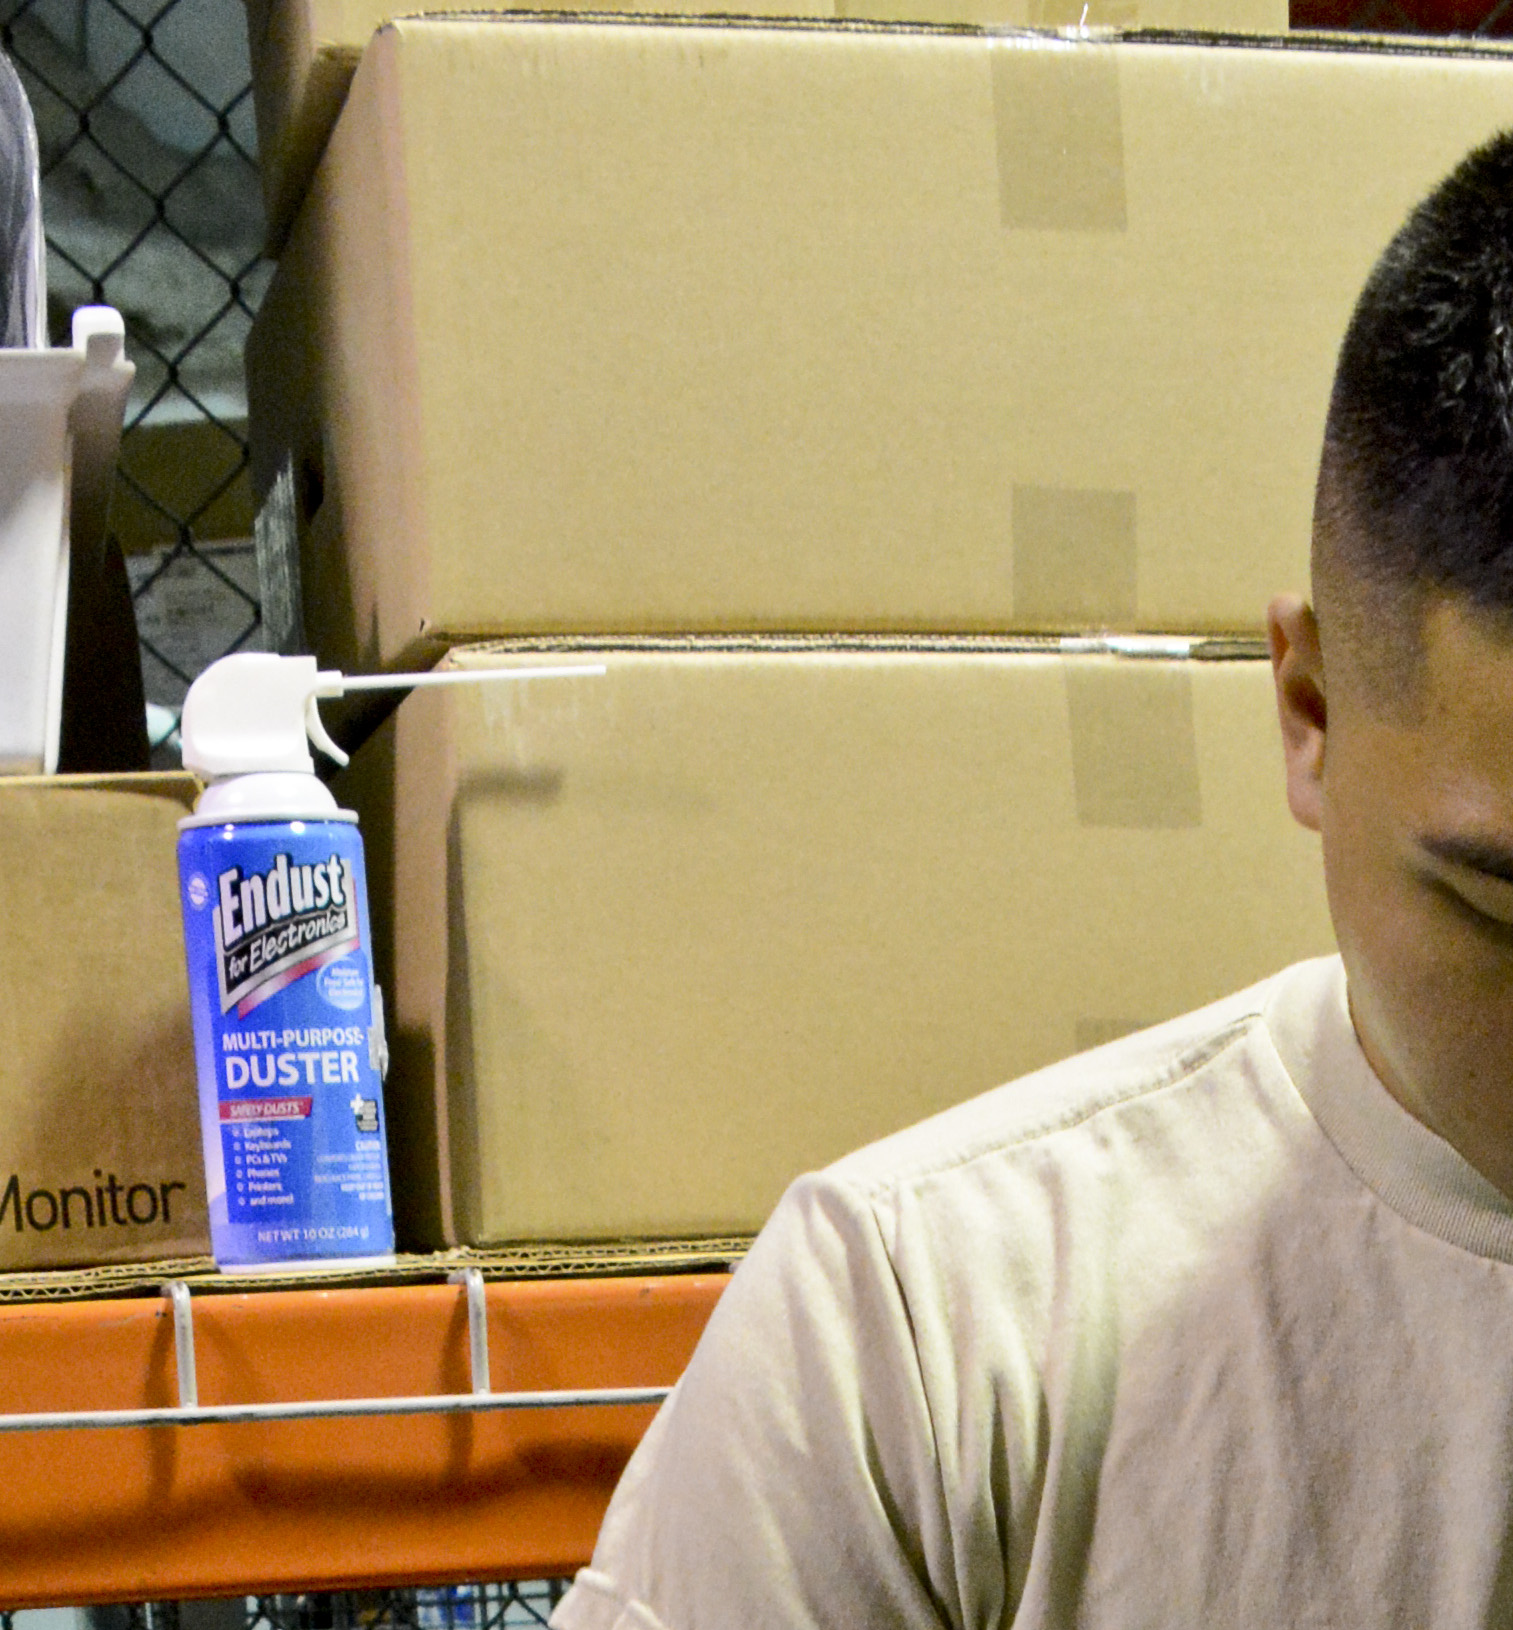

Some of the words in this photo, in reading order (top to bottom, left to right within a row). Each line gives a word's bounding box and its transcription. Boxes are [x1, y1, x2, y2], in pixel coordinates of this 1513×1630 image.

[219, 854, 344, 947] Endust
[229, 954, 249, 979] for
[250, 912, 346, 972] Electronics
[222, 1027, 362, 1051] MULTI-PURPOSE
[225, 1051, 359, 1090] DUSTER
[258, 1230, 279, 1243] NET
[280, 1229, 299, 1242] WT
[304, 1229, 316, 1240] 10
[318, 1228, 335, 1239] OZ
